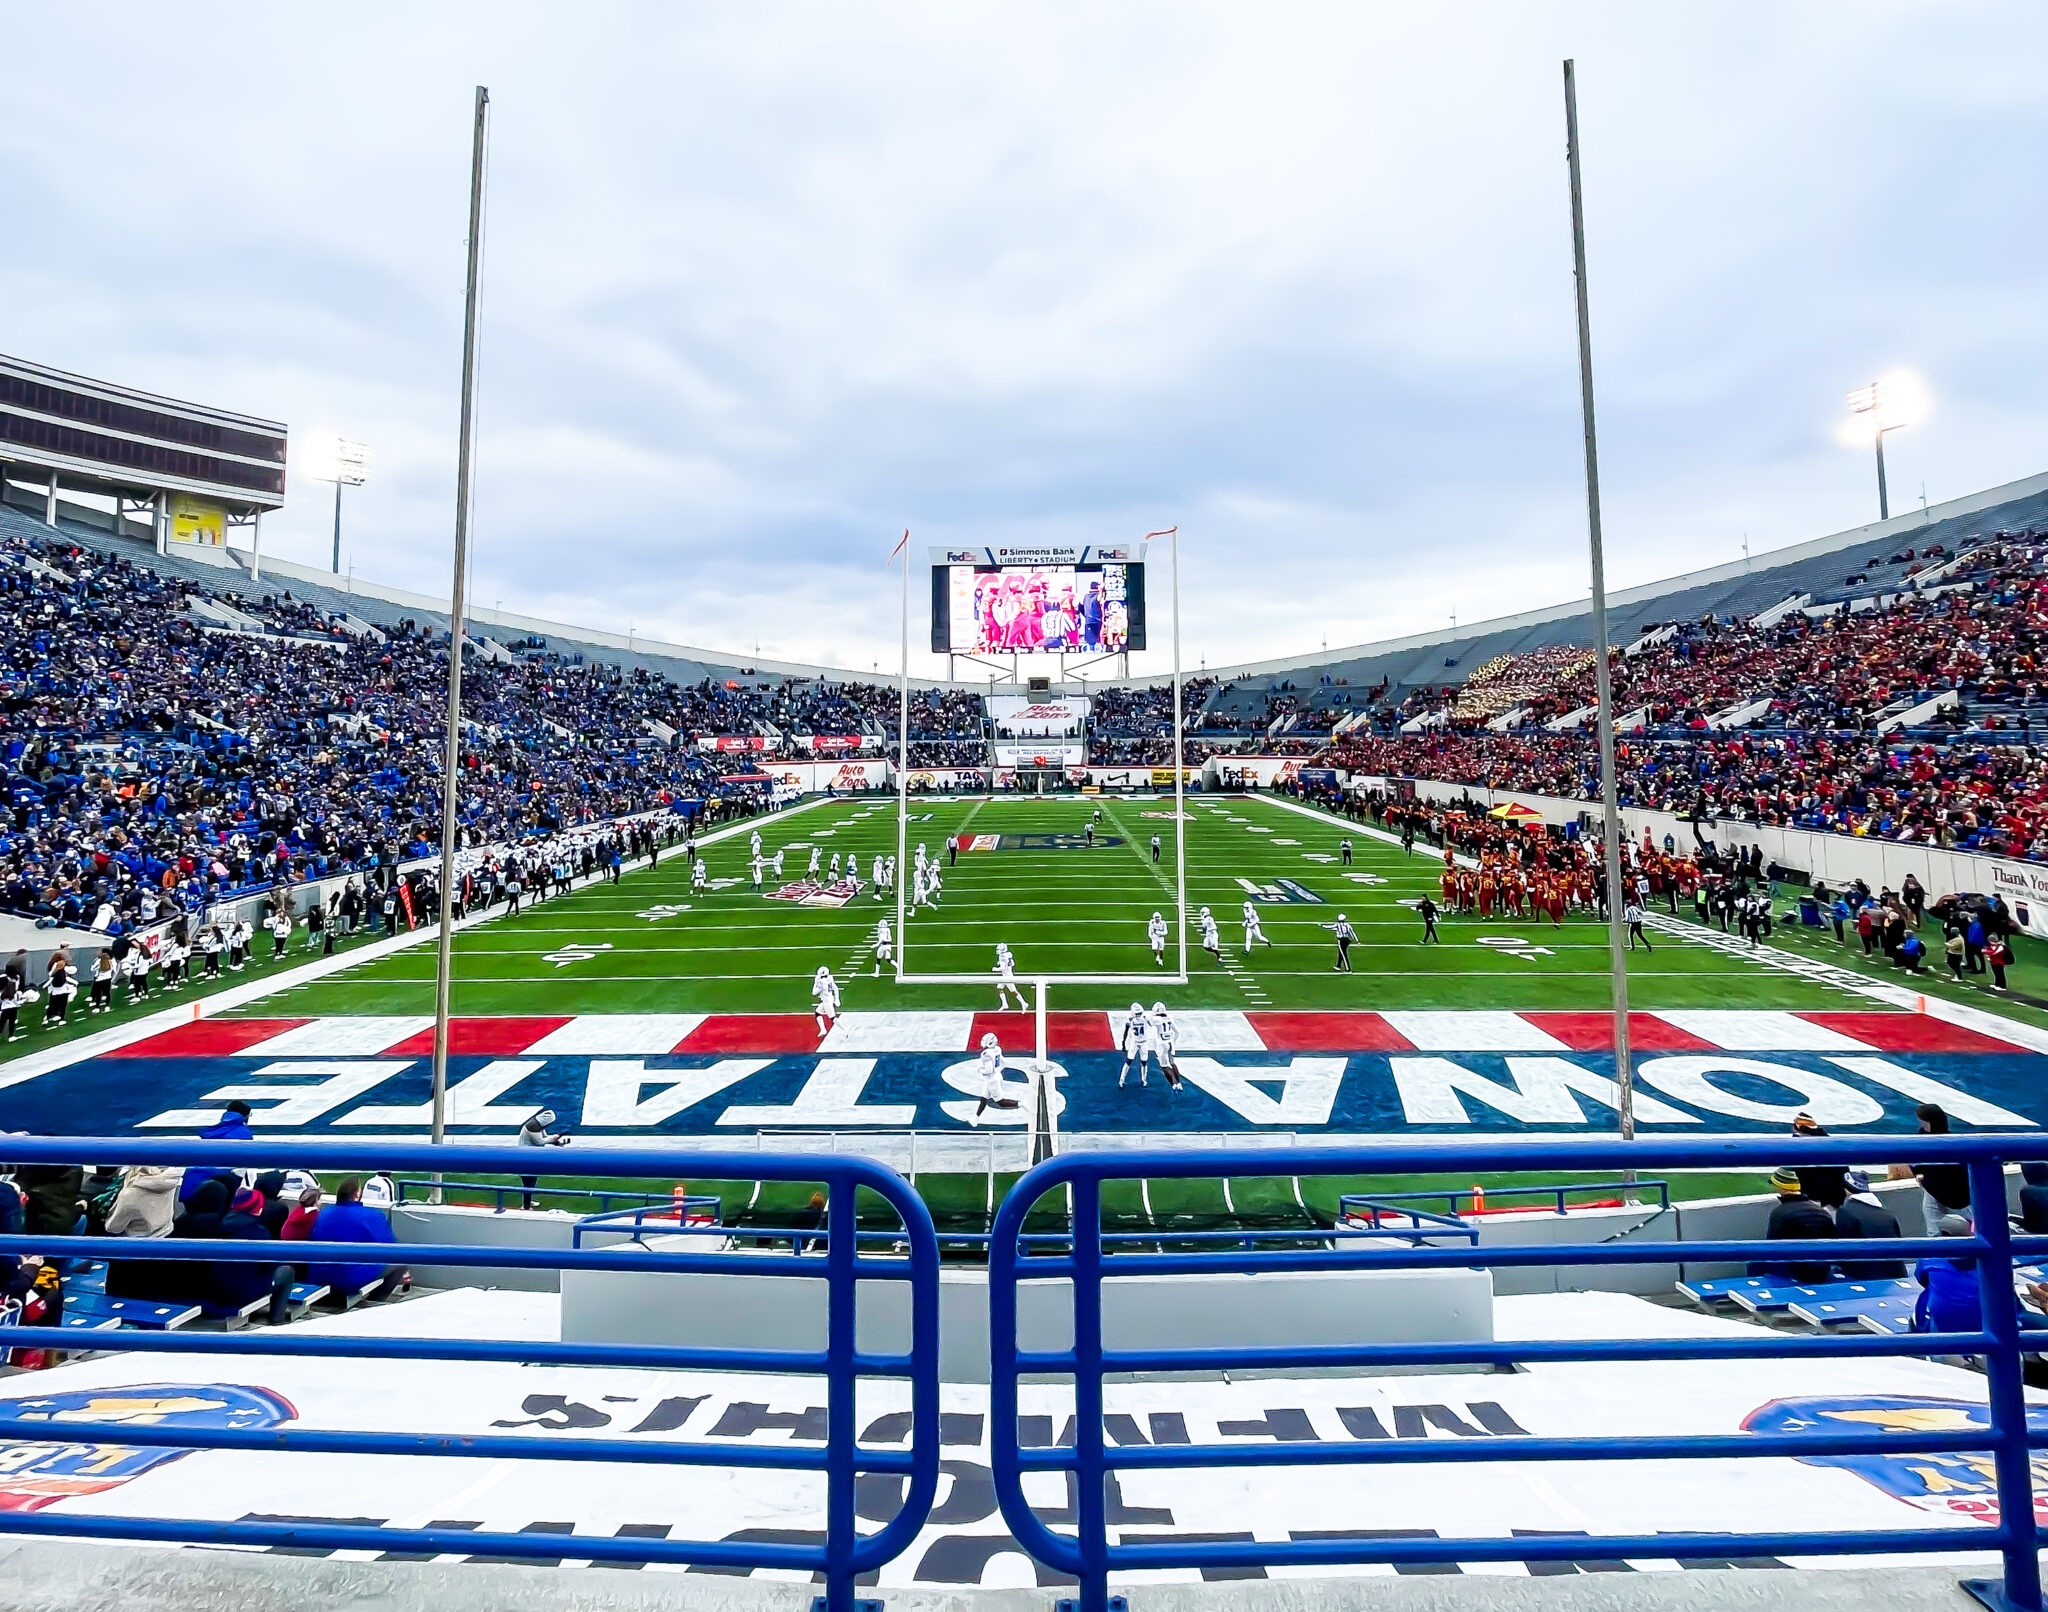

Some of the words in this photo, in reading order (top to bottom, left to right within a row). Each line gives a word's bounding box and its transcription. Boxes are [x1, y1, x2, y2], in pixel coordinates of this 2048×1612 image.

[1009, 548, 1050, 556] Simmons
[1053, 547, 1075, 555] Bank
[839, 764, 865, 776] Auto
[1223, 766, 1259, 778] FedEx
[1281, 760, 1302, 772] Aut
[773, 772, 801, 786] edEx
[1991, 866, 2029, 887] Thank
[541, 943, 614, 962] 10
[133, 1055, 1068, 1129] STATE
[1185, 1055, 2039, 1127] IOWA
